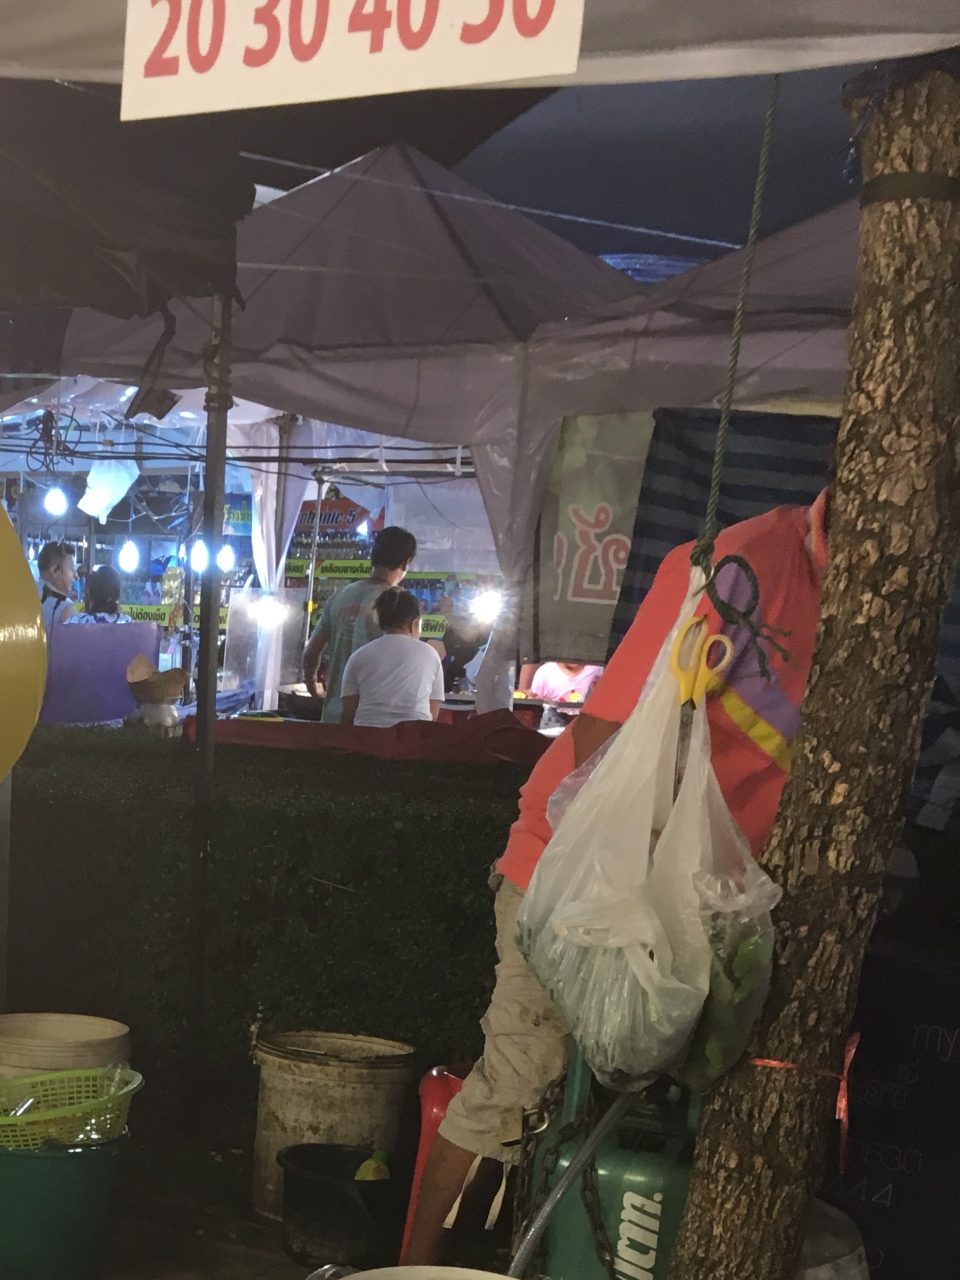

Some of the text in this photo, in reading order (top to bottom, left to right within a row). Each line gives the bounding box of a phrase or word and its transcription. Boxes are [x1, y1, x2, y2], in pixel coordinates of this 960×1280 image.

[143, 0, 226, 78] 20
[242, 0, 329, 68] 30
[348, 0, 439, 54] 40
